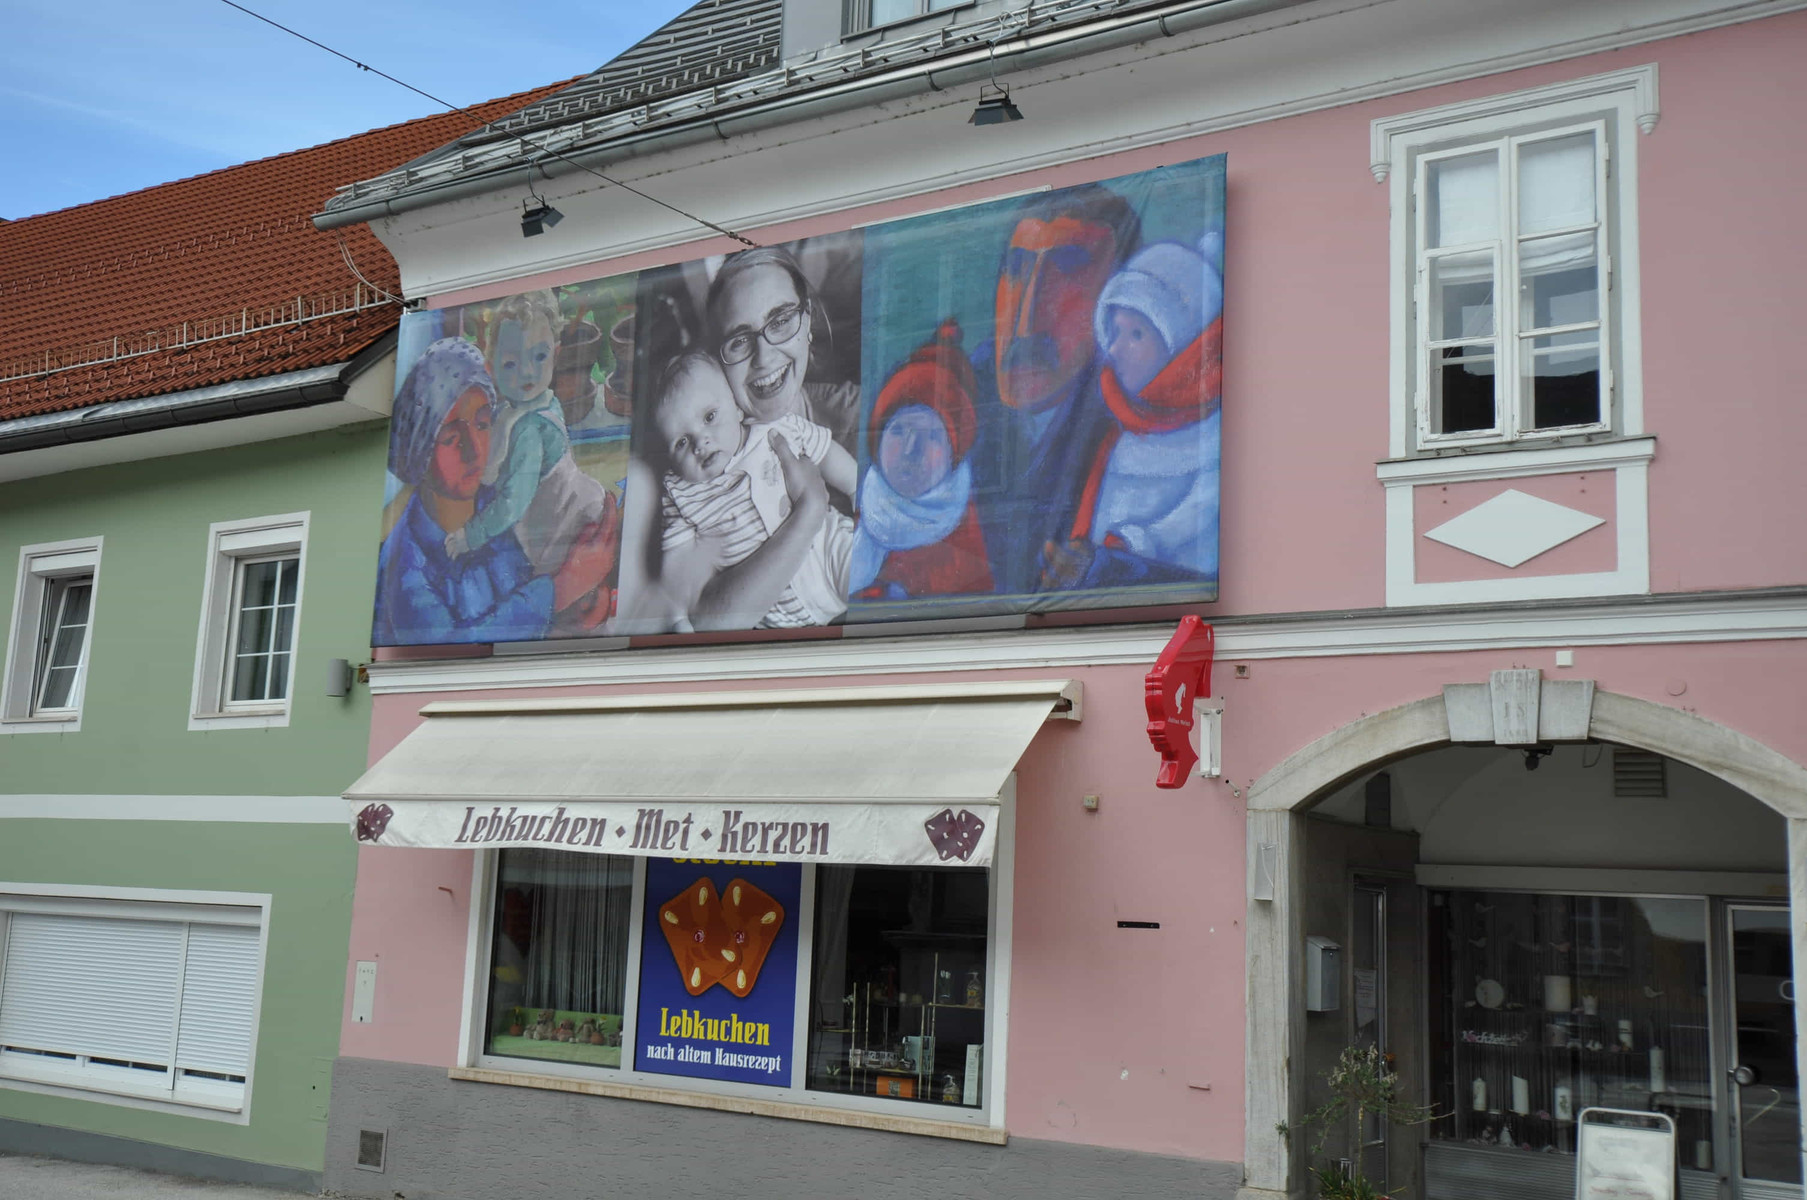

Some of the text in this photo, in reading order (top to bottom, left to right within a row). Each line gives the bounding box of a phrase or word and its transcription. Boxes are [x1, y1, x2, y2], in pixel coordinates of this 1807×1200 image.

[454, 806, 830, 855] Lebkuchen Met Kerzen
[659, 1007, 770, 1046] Lebkuchen
[646, 1043, 782, 1074] nach altem Hausrezept
